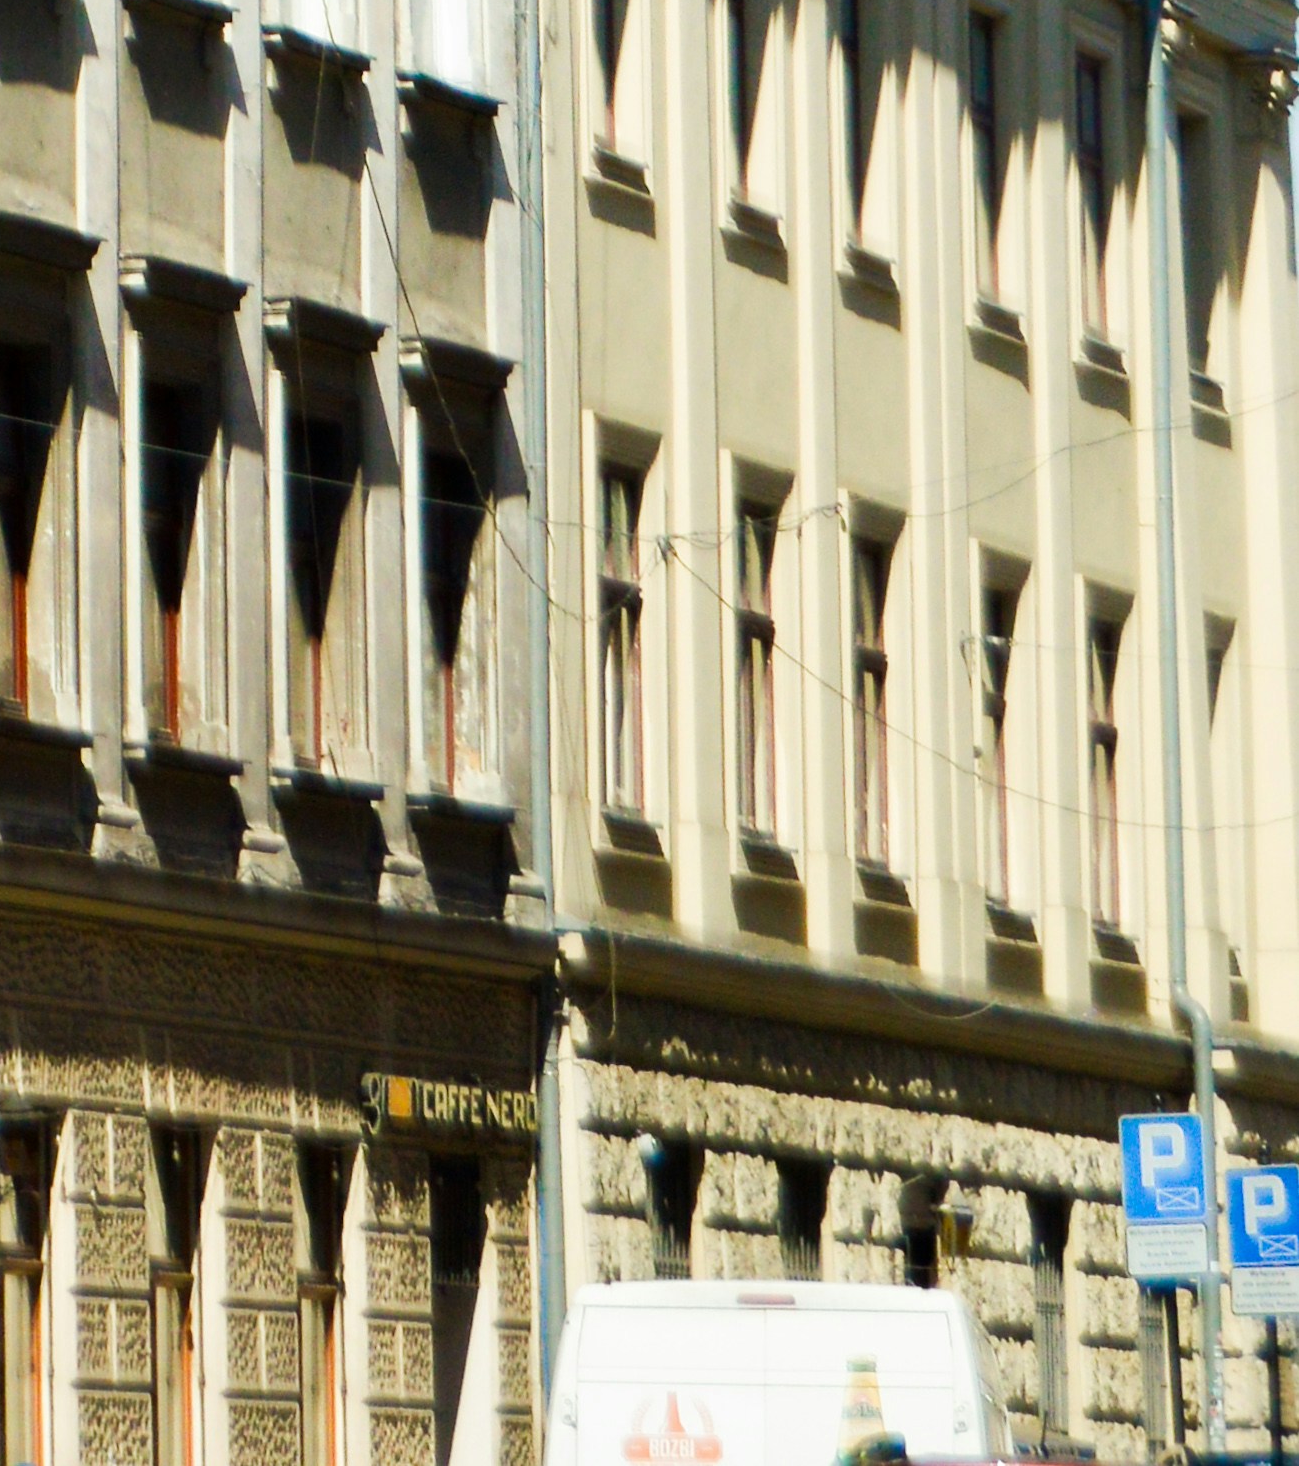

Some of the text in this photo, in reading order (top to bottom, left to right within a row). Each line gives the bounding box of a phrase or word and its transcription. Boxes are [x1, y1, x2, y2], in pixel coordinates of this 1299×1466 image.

[486, 1090, 538, 1131] NERO
[1139, 1123, 1186, 1187] P
[1242, 1175, 1286, 1236] P
